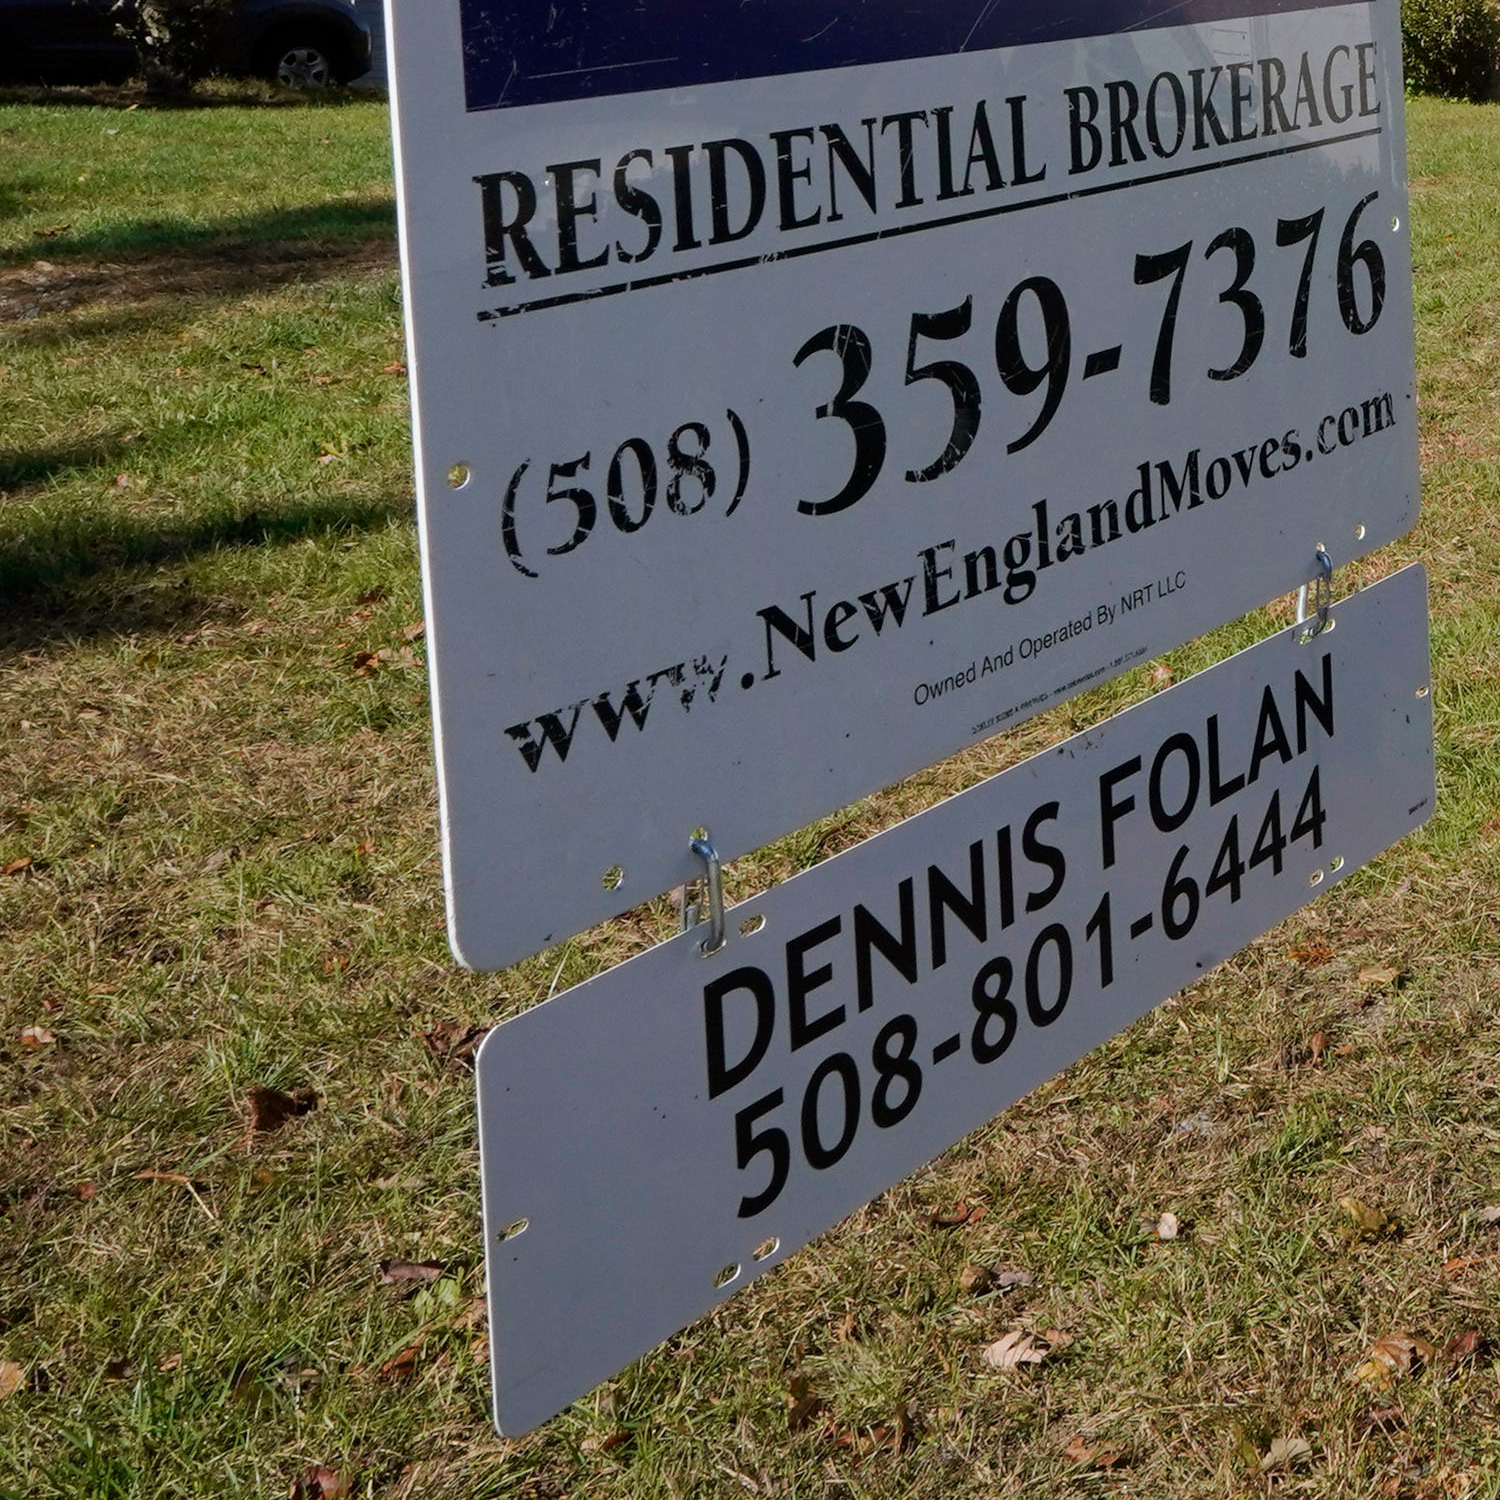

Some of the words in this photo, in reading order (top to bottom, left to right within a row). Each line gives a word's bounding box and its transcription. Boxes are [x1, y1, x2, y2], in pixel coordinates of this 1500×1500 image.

[472, 94, 1046, 288] RESIDENTIAL
[1063, 42, 1382, 176] BROKERAGE
[500, 408, 751, 579] (508)
[791, 190, 1387, 517] 359-7376
[914, 661, 976, 706] Owned
[981, 647, 1014, 678] And
[1018, 612, 1092, 660] Operated
[1096, 603, 1116, 626] By
[1120, 583, 1154, 615] NRT
[1157, 569, 1187, 599] LLC
[702, 801, 1067, 1100] DENNIS
[1099, 652, 1335, 868] FOLAN
[734, 765, 1327, 1220] 508-801-6444
